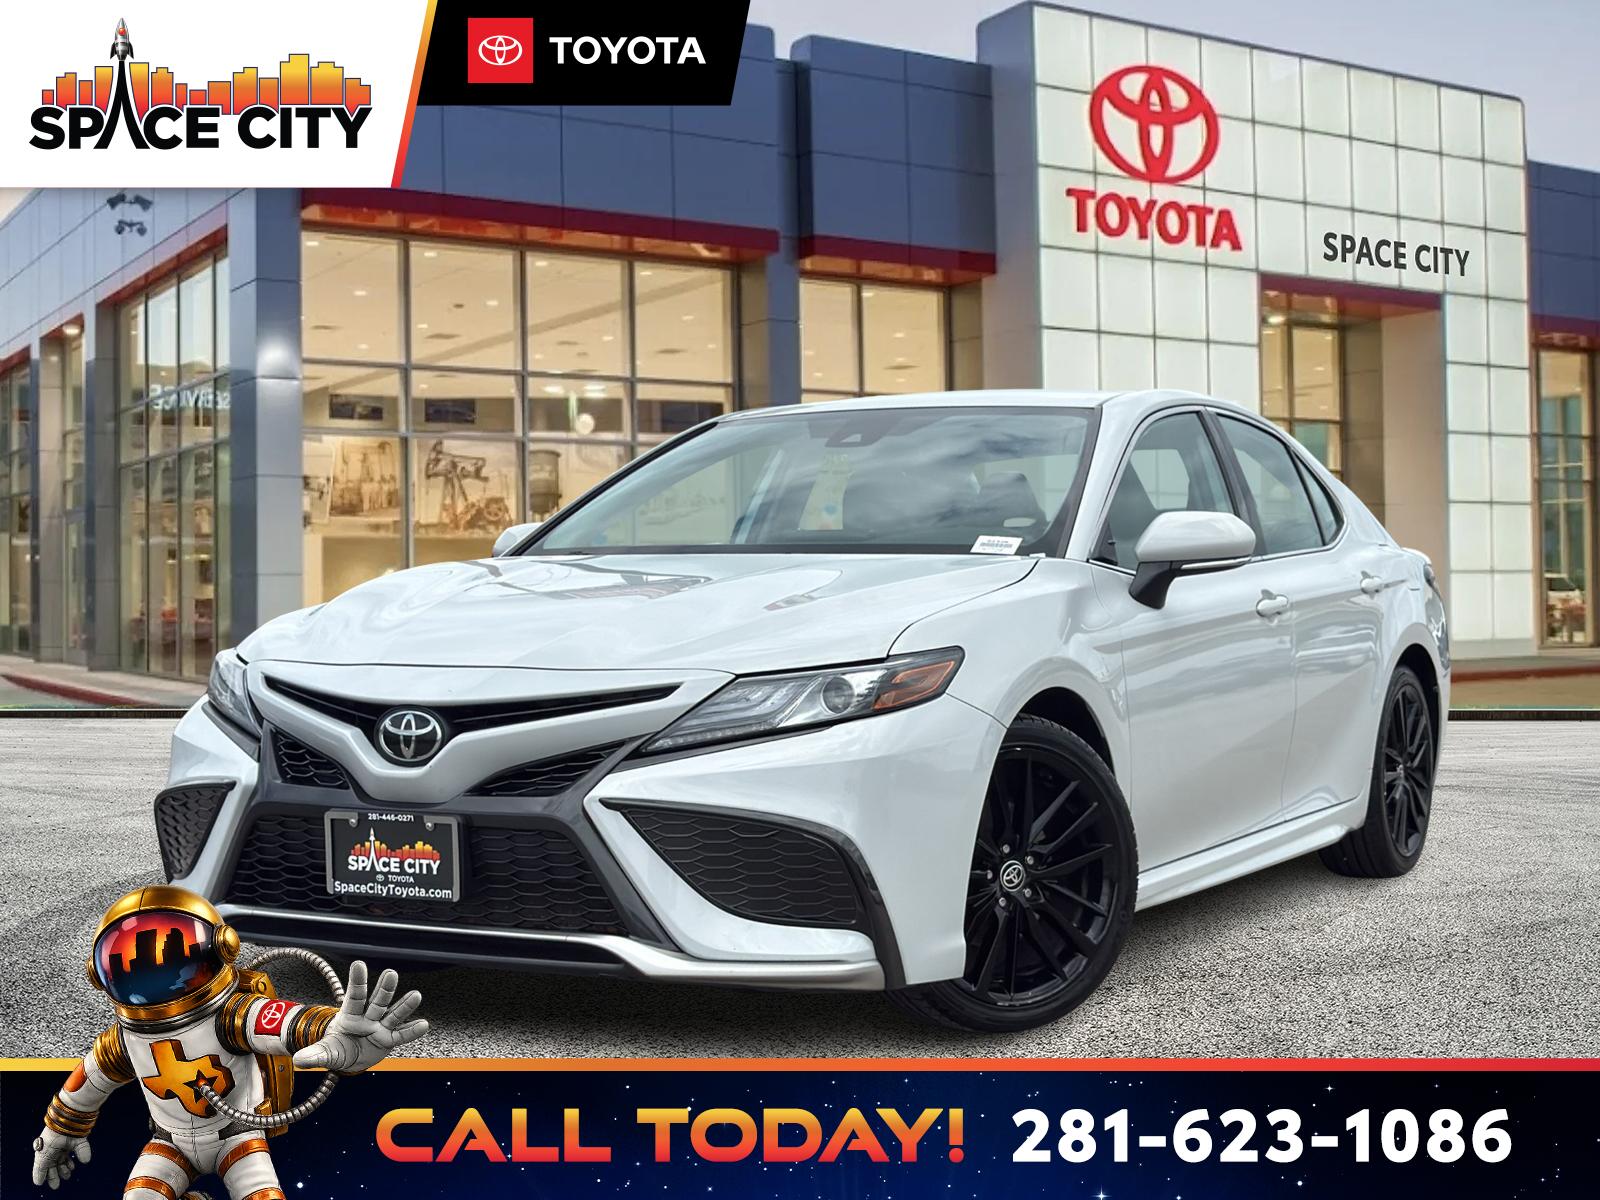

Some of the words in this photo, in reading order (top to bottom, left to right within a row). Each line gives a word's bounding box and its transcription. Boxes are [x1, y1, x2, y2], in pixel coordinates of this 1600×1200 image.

[1065, 187, 1243, 252] TOYOTA
[1322, 231, 1407, 271] SPACE
[1414, 243, 1471, 277] CITY
[367, 812, 415, 823] 281-446-0271
[347, 854, 401, 873] SPACE
[403, 858, 441, 875] CITY
[387, 874, 415, 883] TOYOTA
[334, 880, 453, 899] SpaceCityToyota.com
